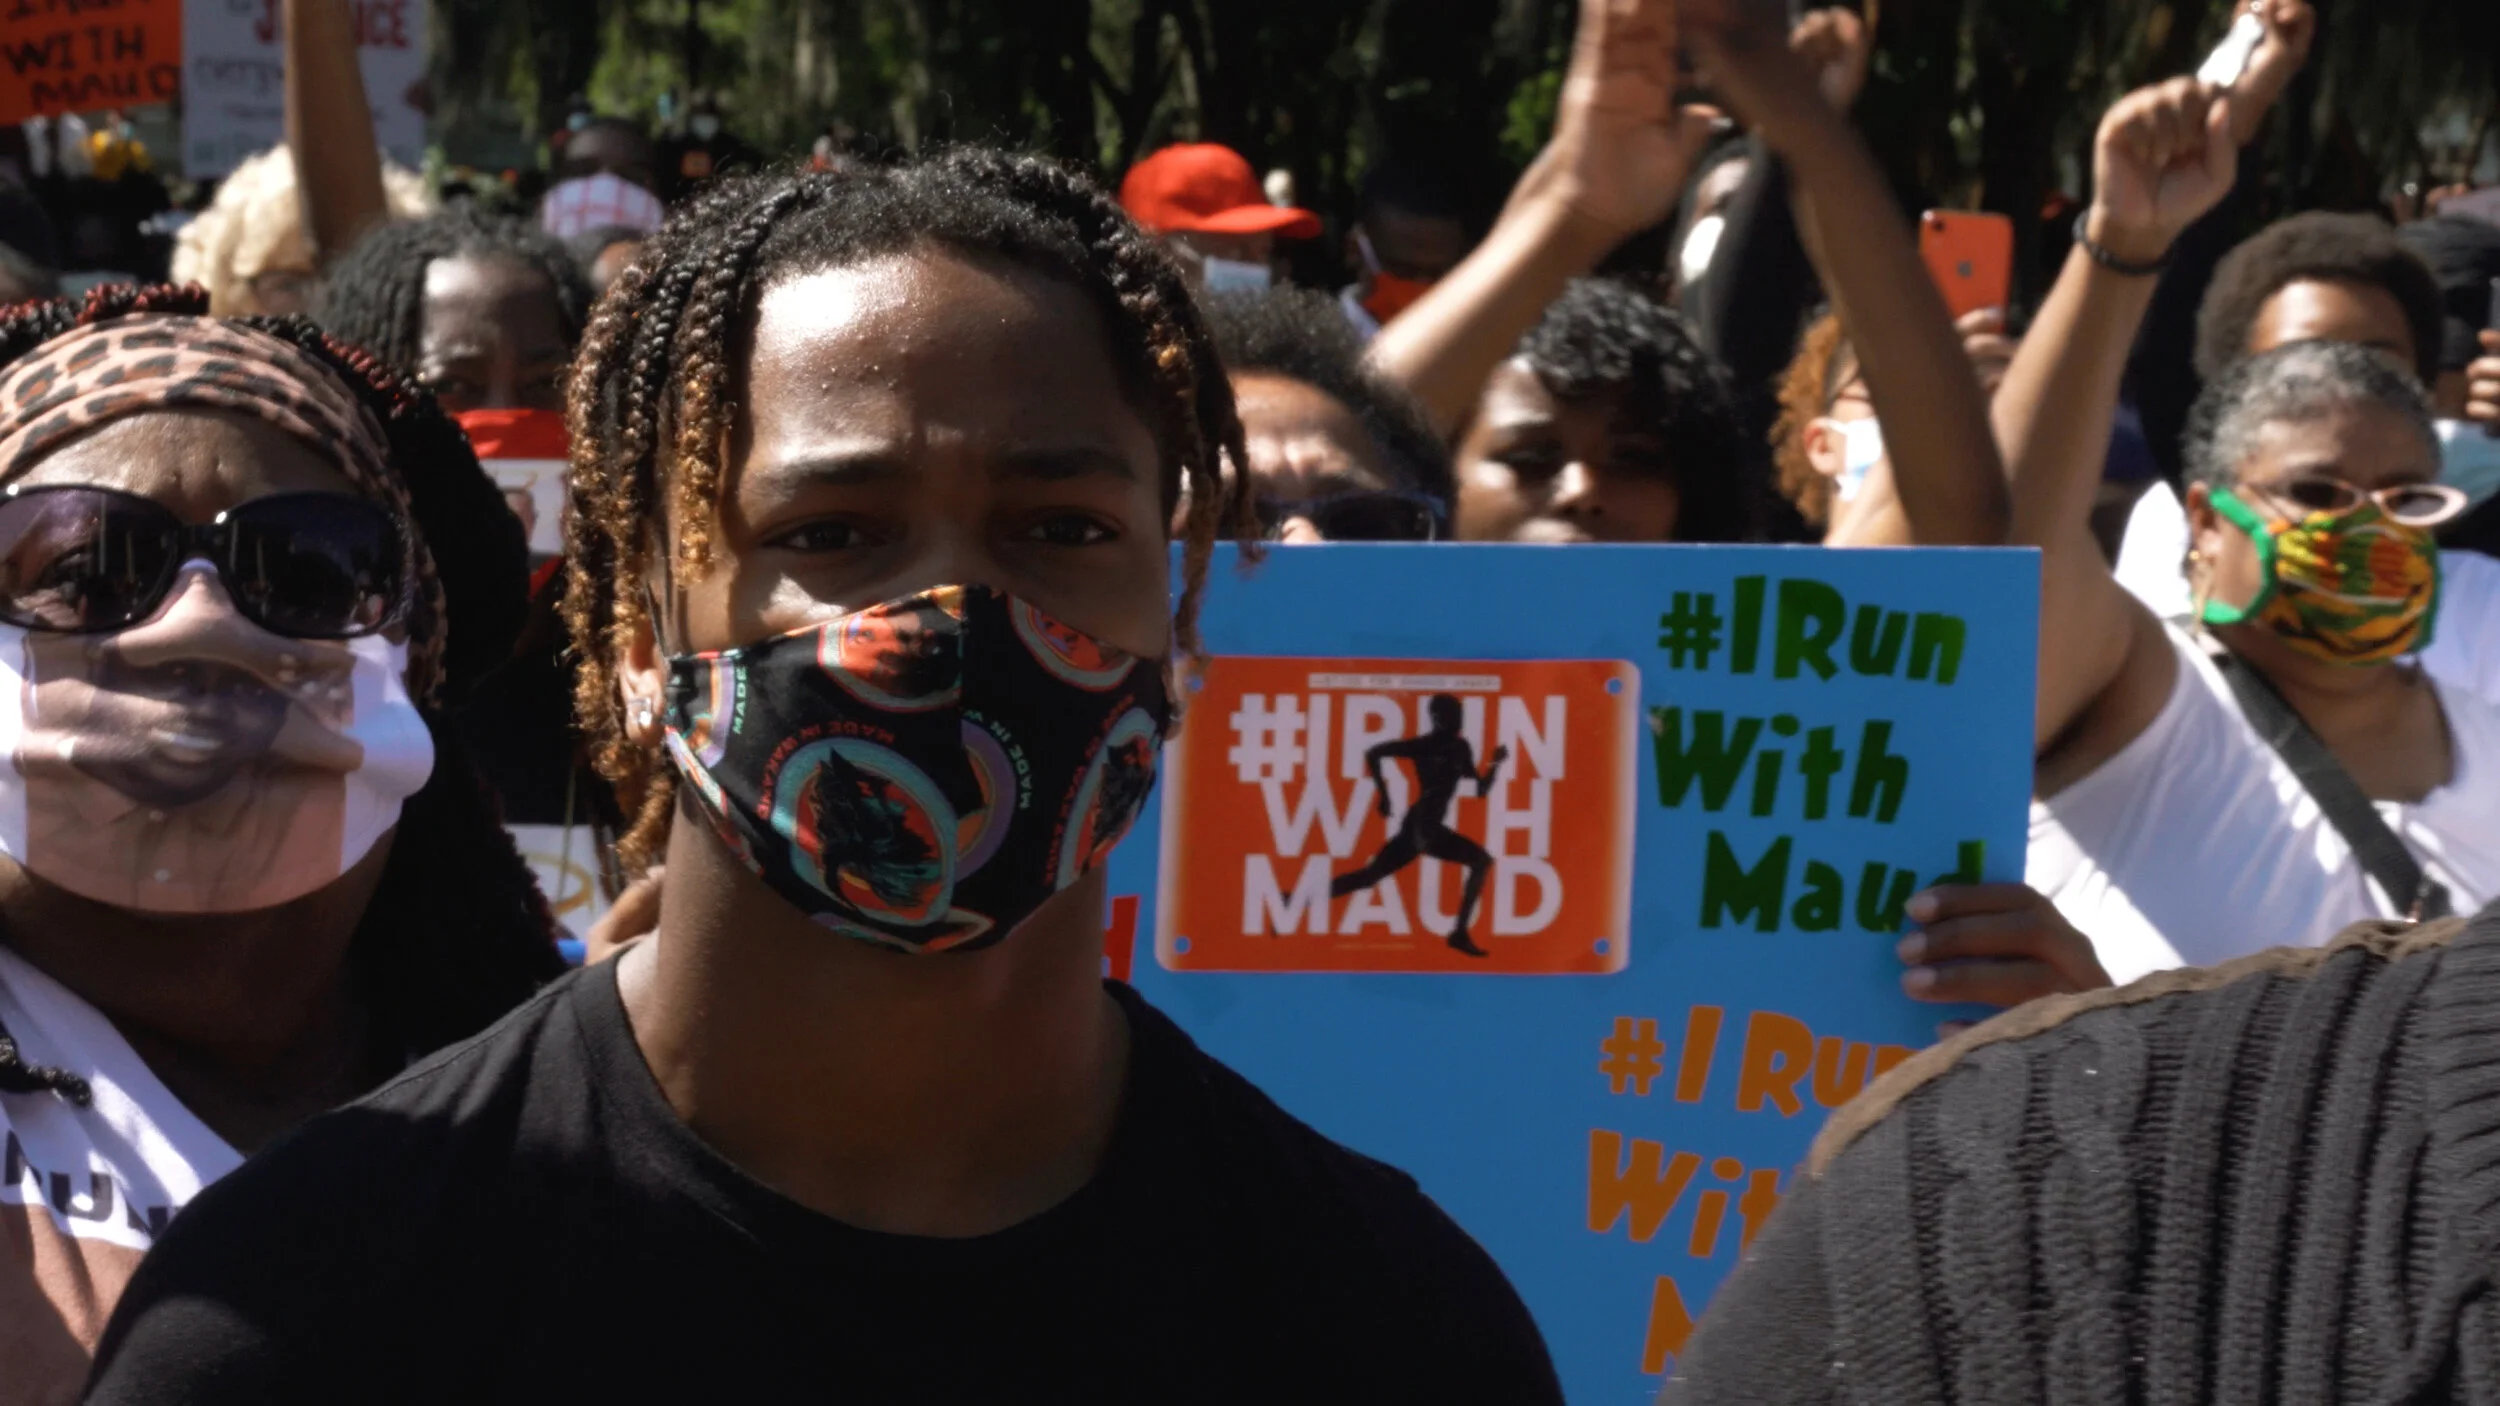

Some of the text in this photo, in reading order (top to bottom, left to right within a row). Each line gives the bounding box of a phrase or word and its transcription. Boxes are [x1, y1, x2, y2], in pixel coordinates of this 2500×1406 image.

[3, 24, 145, 74] WITH
[254, 0, 411, 48] JICE
[1658, 575, 1967, 686] #IRun
[733, 664, 747, 735] MADE
[989, 720, 1033, 811] MADE IN
[1650, 705, 1910, 824] With
[1241, 853, 1563, 938] MAUD
[1587, 1128, 1786, 1258] Wit
